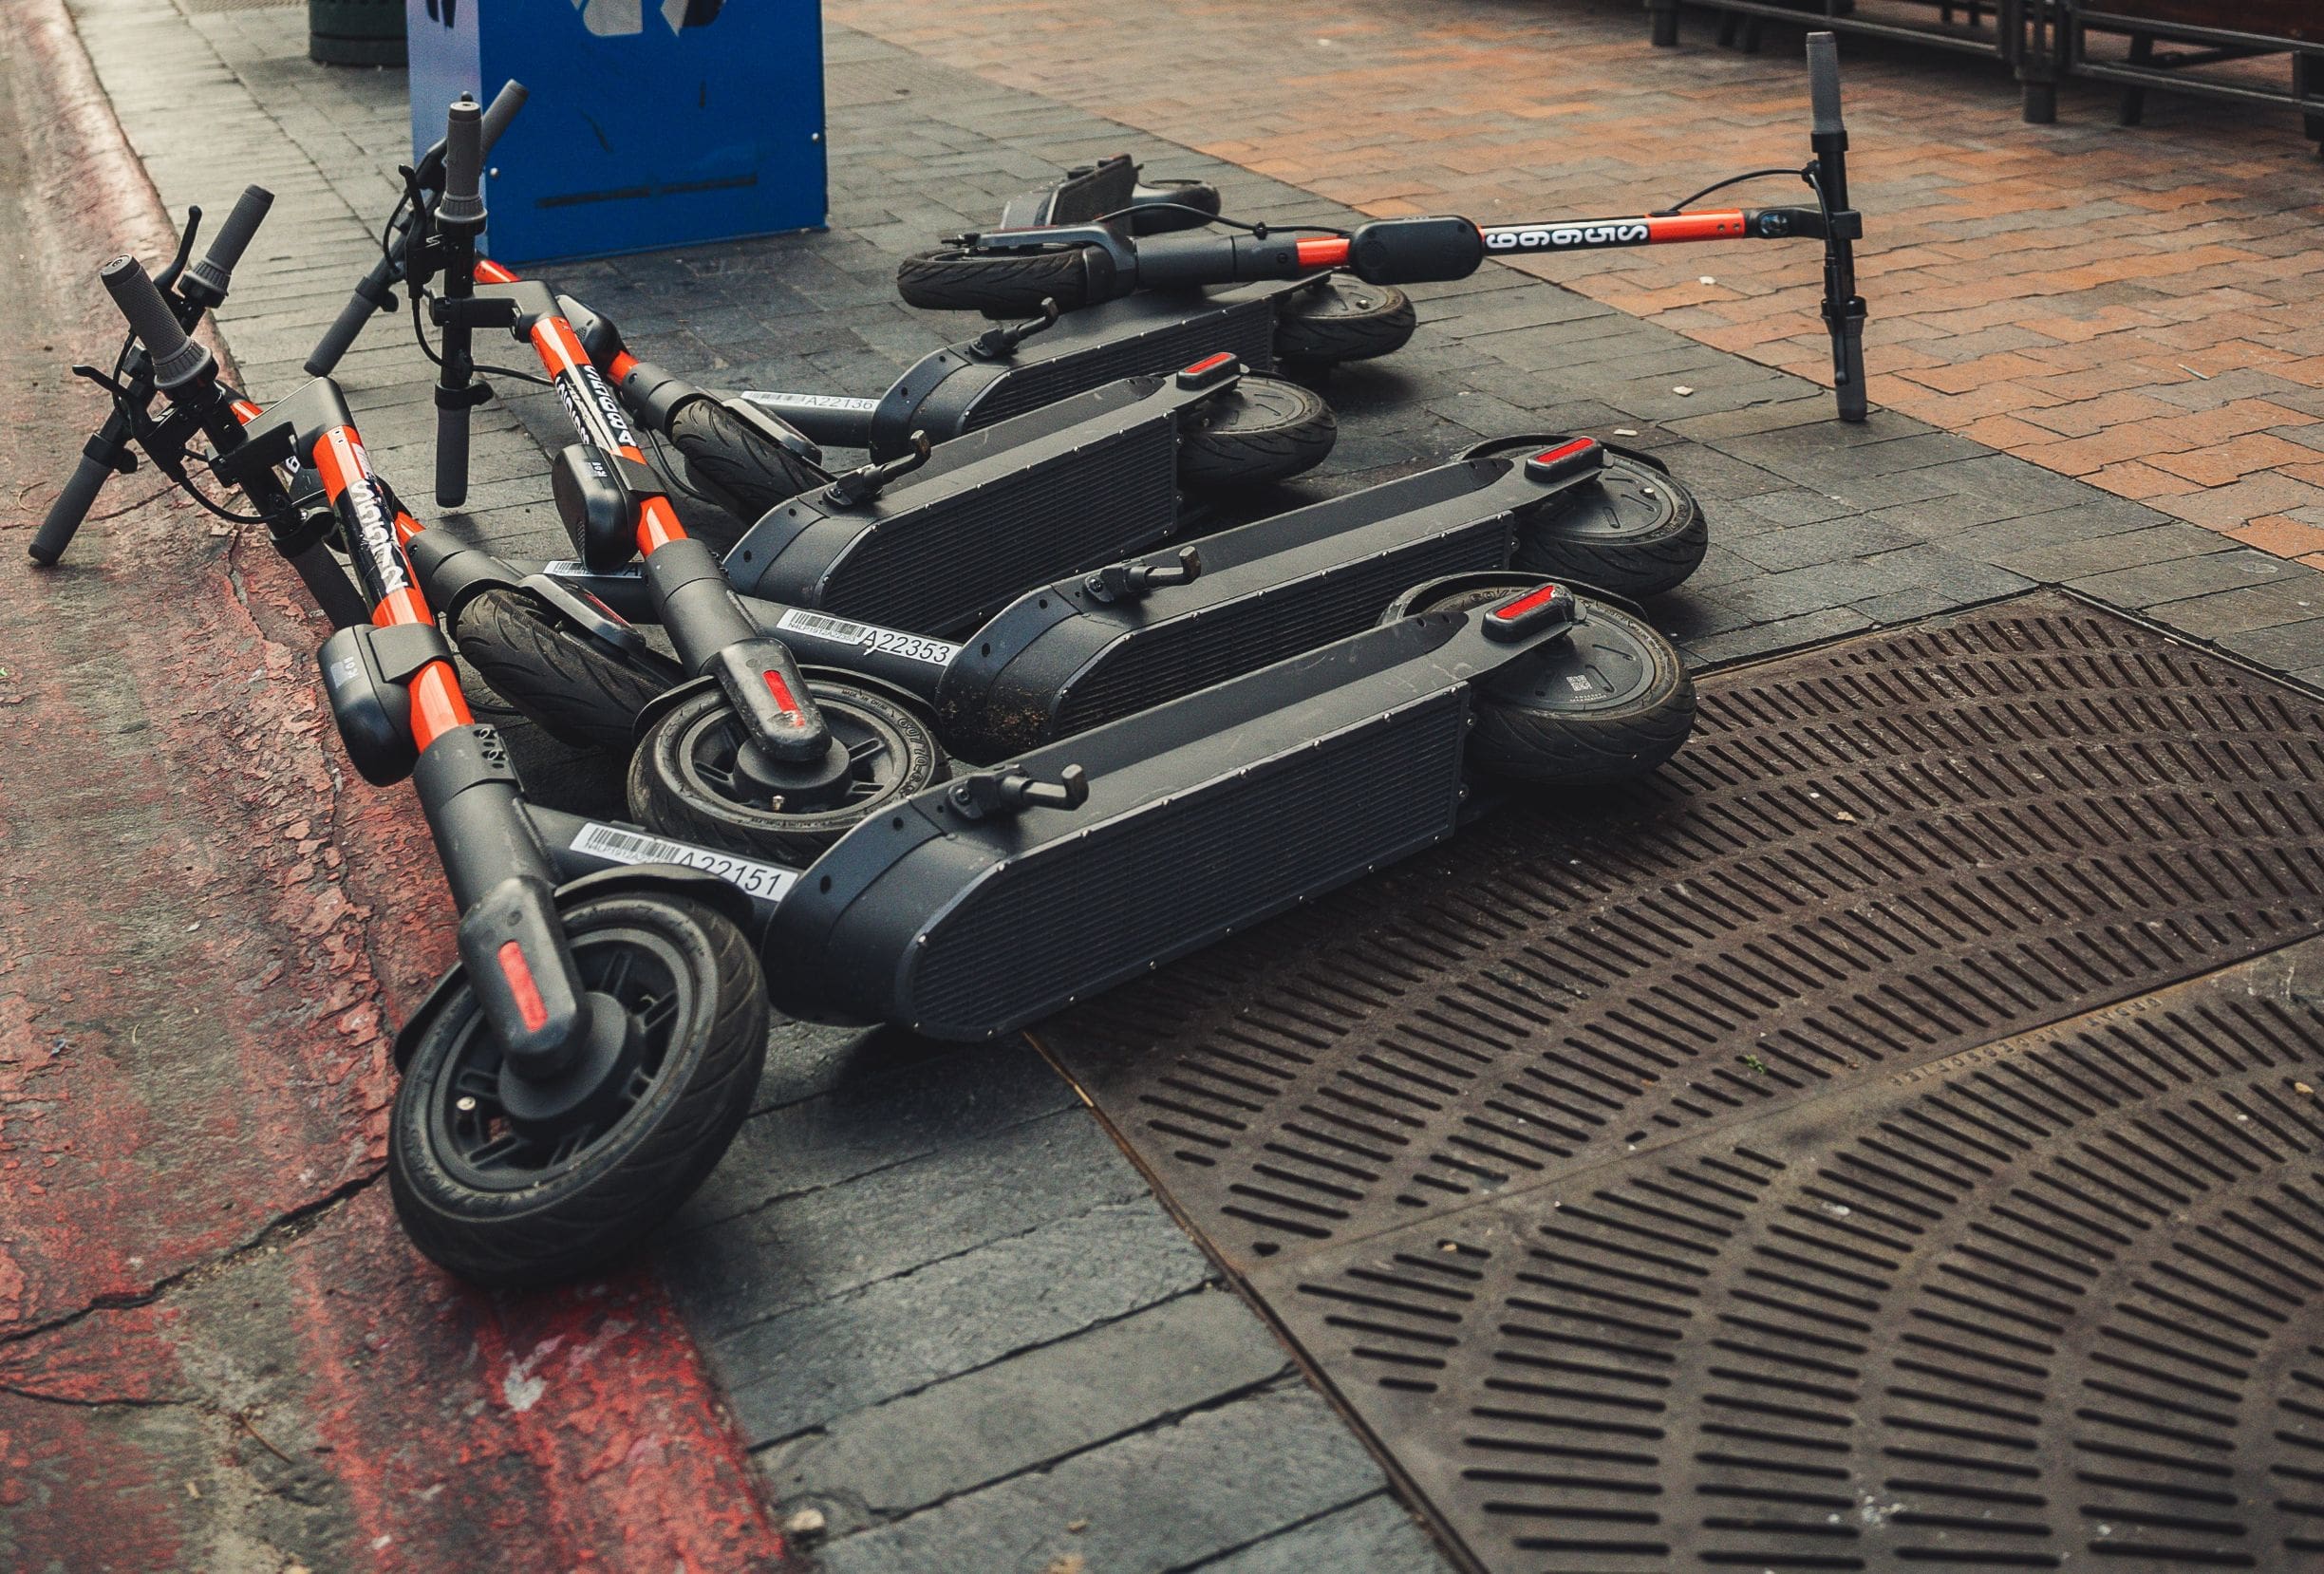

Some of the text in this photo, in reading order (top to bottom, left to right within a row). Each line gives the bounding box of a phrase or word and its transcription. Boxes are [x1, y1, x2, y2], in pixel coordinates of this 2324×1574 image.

[806, 395, 874, 410] A22136
[350, 478, 409, 594] S5572
[859, 629, 951, 663] A22353
